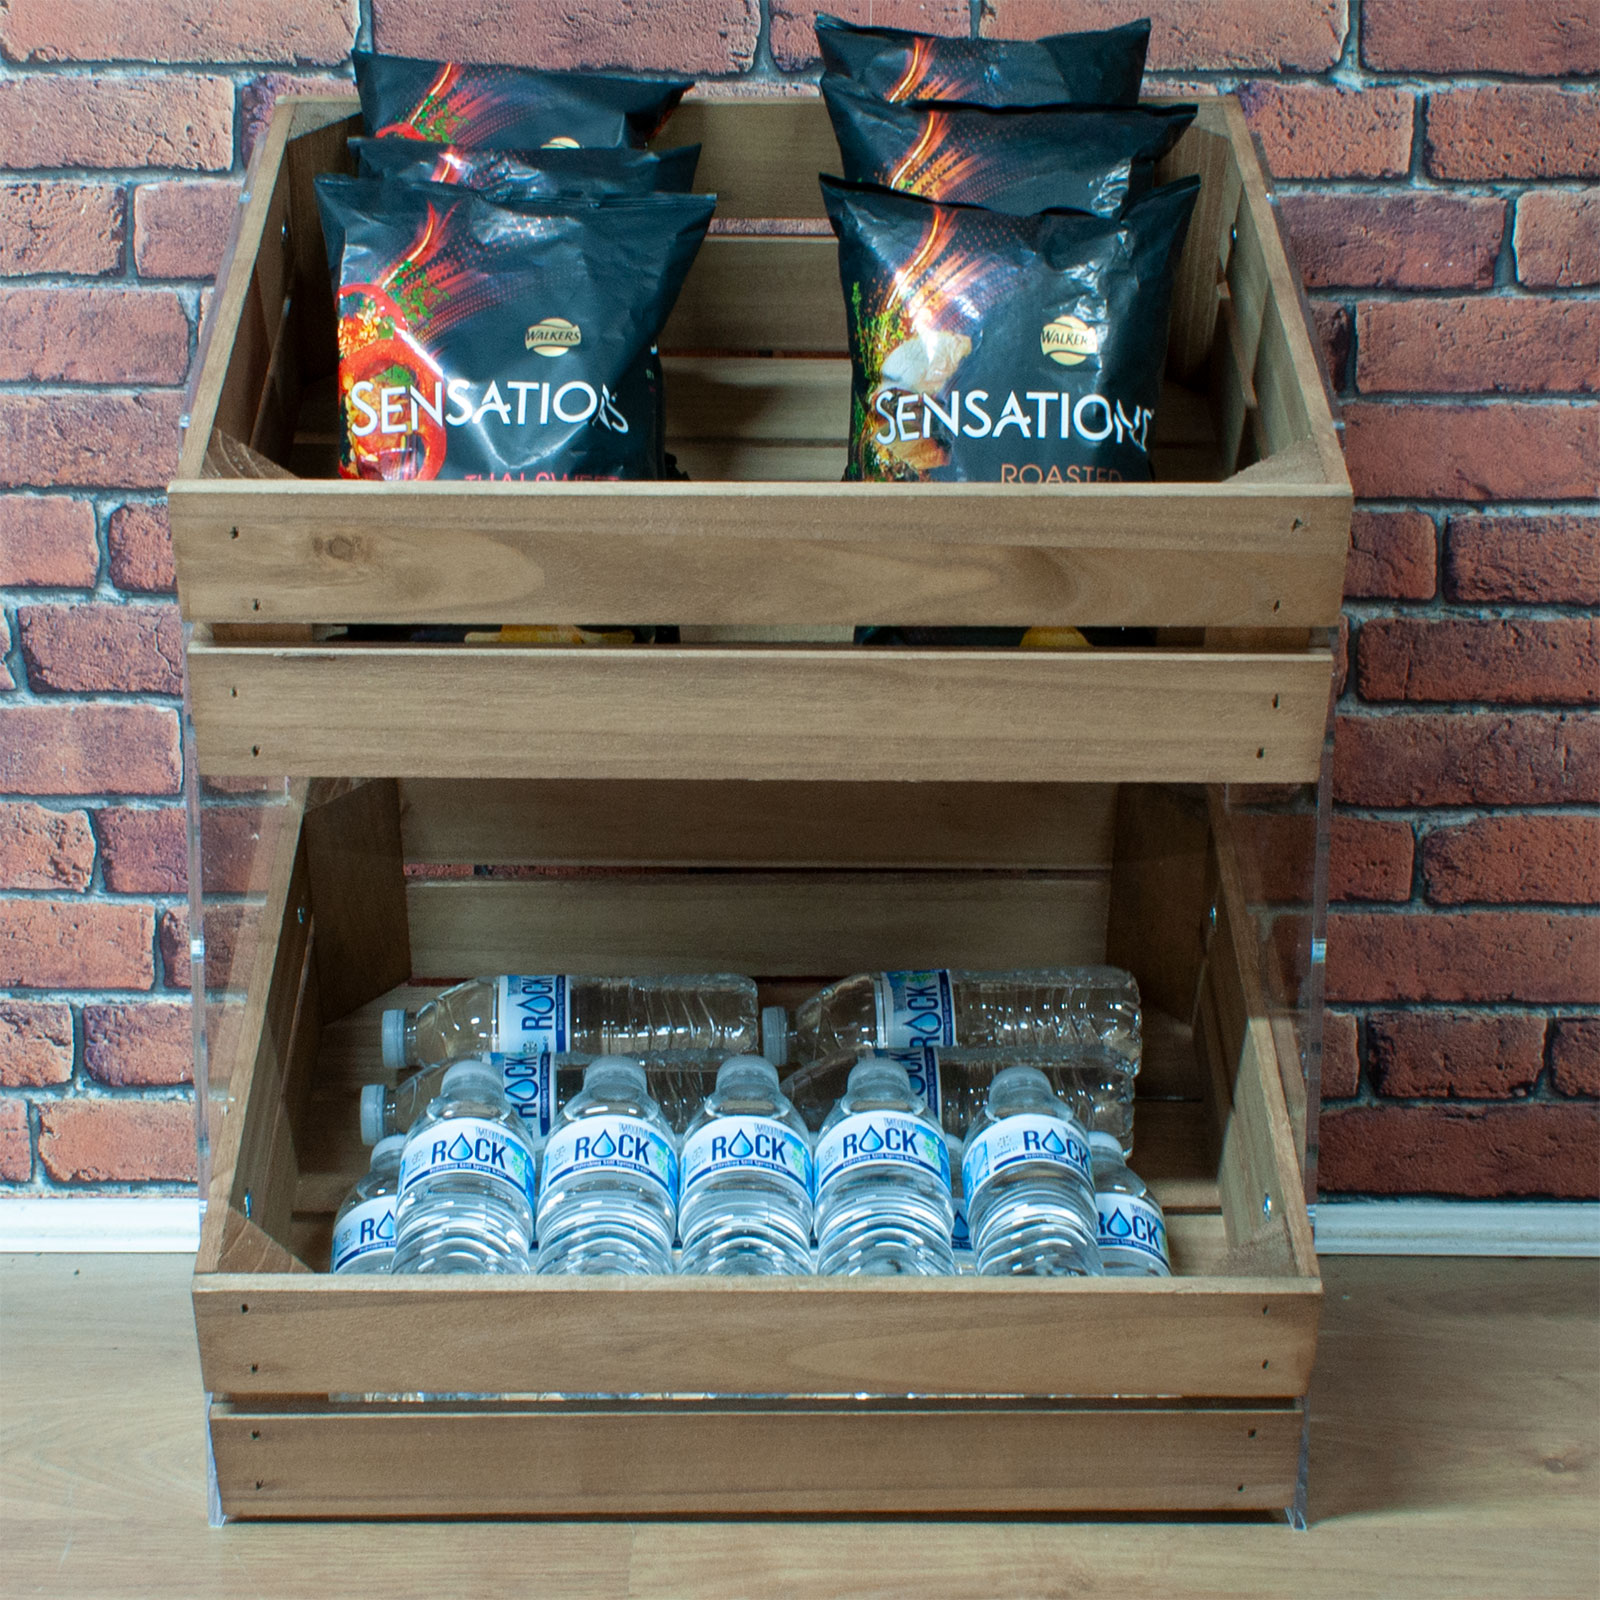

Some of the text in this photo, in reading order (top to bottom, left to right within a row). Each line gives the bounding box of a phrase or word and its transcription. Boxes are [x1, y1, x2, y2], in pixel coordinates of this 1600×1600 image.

[526, 329, 580, 342] WALKERS
[1041, 329, 1092, 347] WALKER
[1001, 464, 1122, 483] ROASTED
[517, 977, 555, 1031] ROCK
[431, 1131, 507, 1169] ROCK
[575, 1129, 650, 1166] ROCK
[712, 1128, 787, 1165] ROCK
[843, 1124, 919, 1159] ROCK
[1023, 1128, 1090, 1175] ROCK
